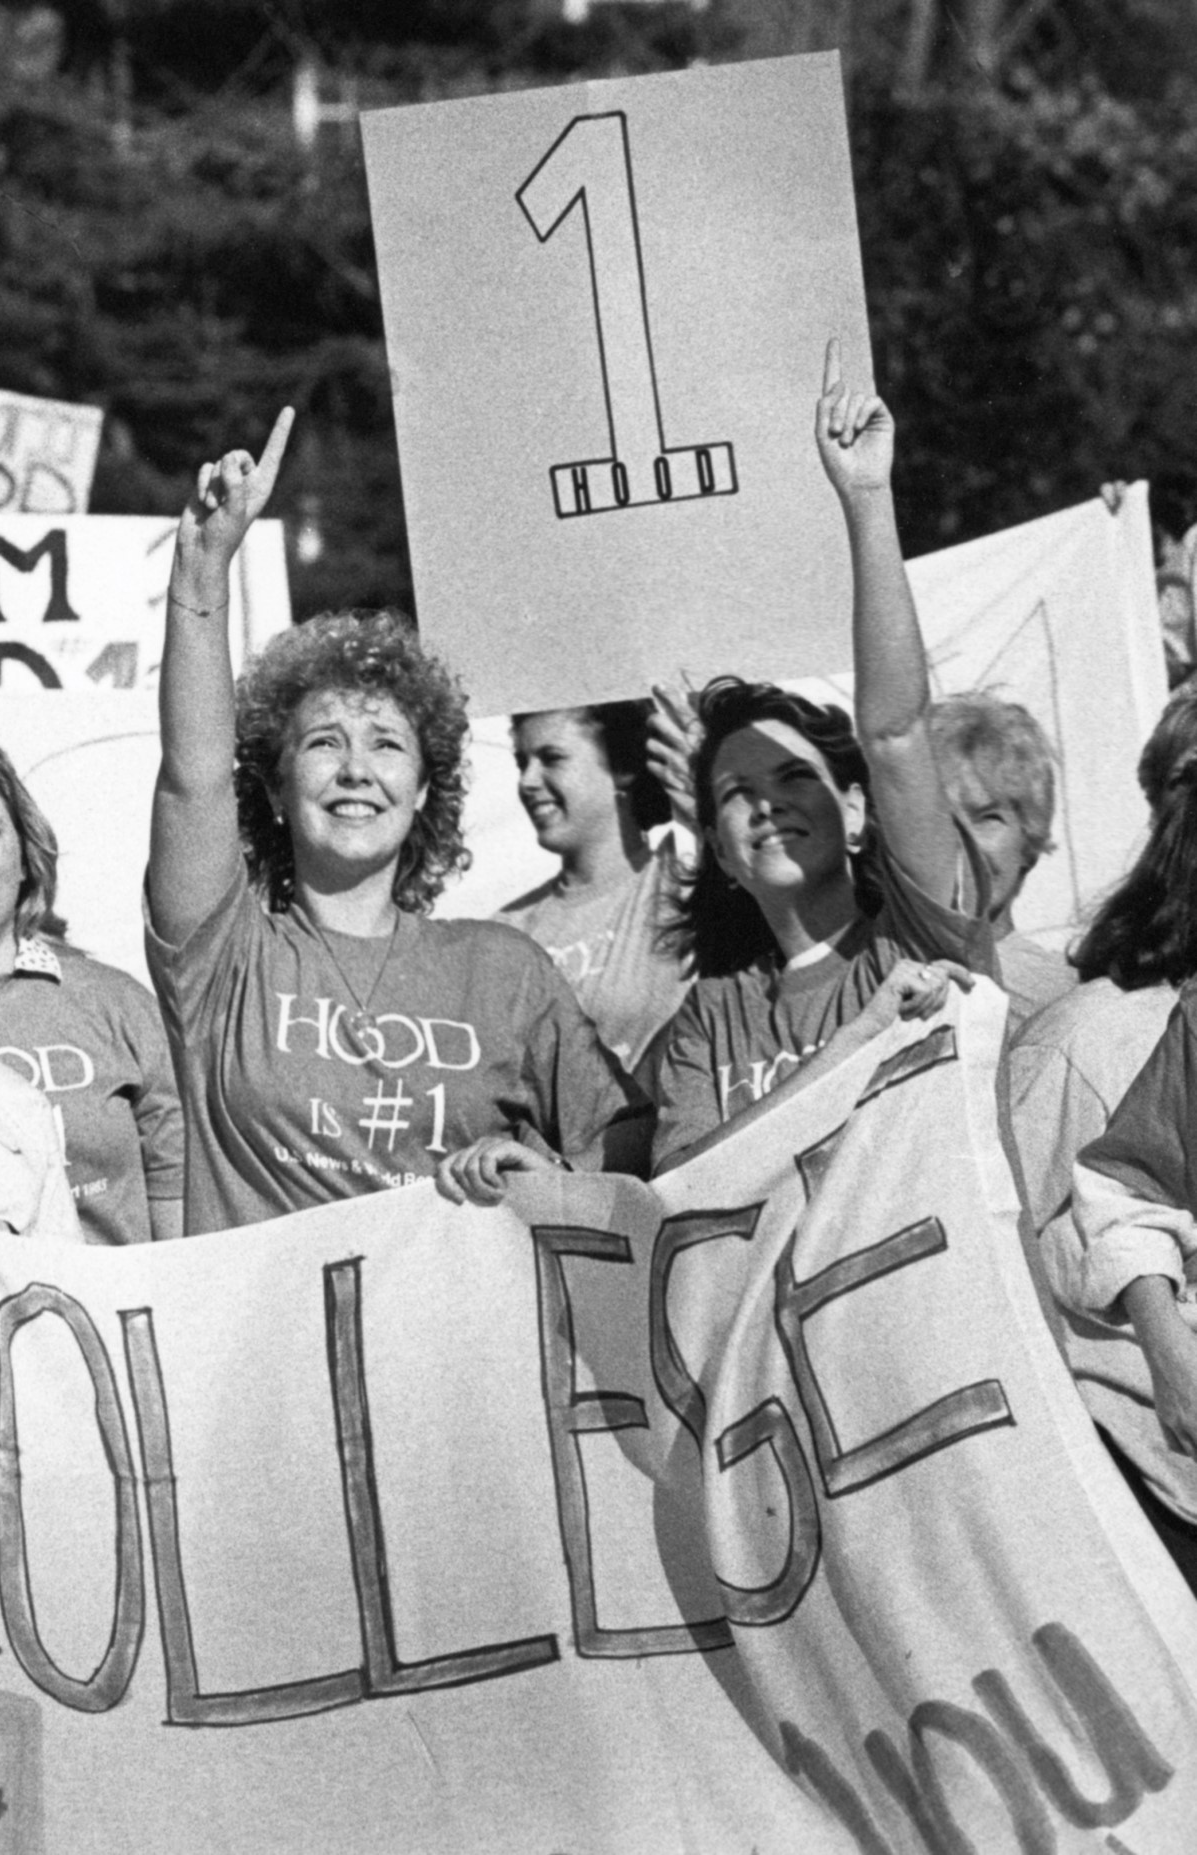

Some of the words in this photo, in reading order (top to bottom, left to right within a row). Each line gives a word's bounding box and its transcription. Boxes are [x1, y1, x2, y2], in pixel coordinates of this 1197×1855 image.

[570, 446, 715, 513] HOOD
[275, 991, 481, 1071] HOOD
[358, 1077, 448, 1153] #1
